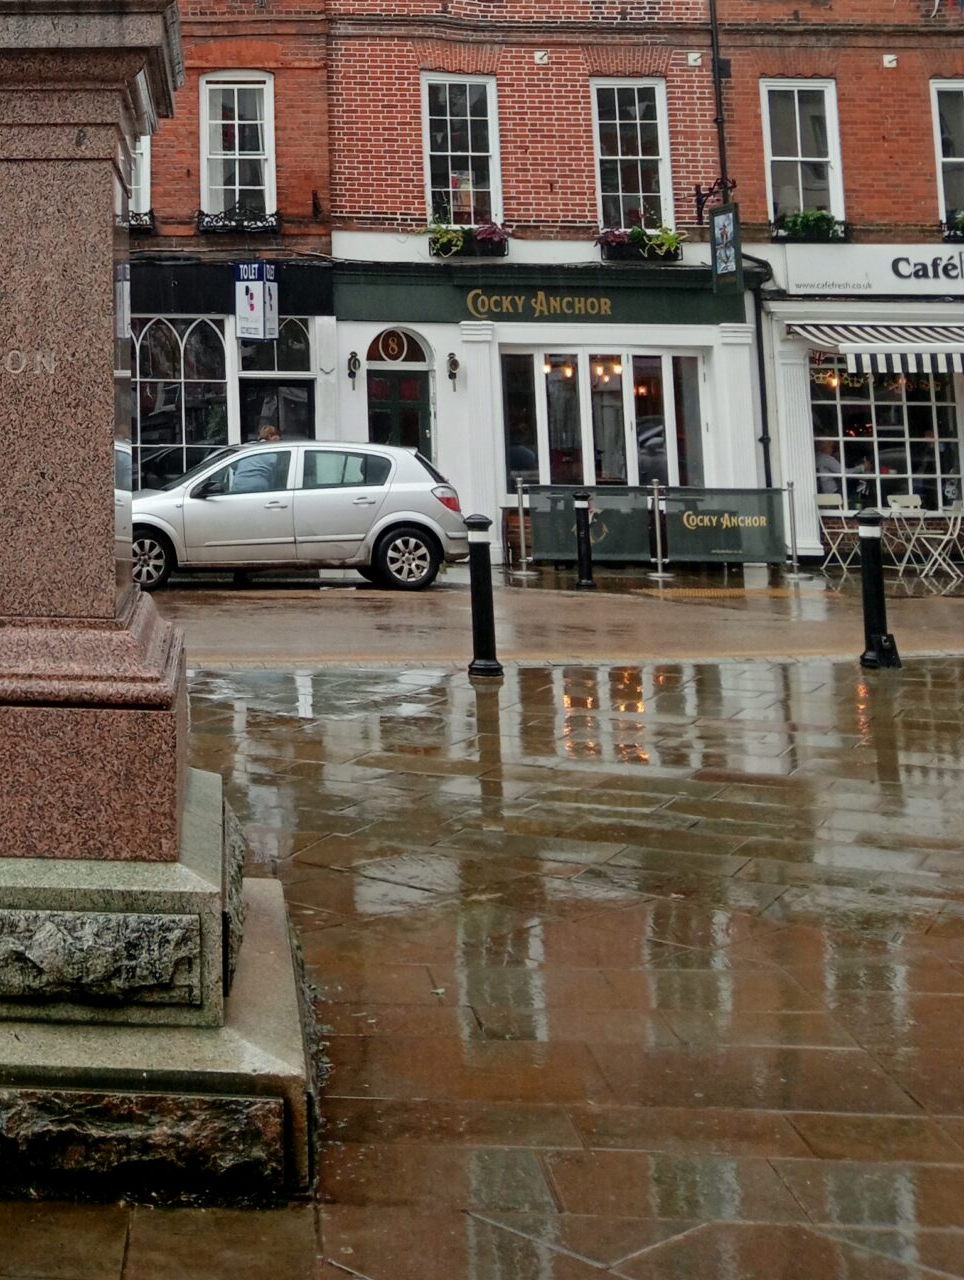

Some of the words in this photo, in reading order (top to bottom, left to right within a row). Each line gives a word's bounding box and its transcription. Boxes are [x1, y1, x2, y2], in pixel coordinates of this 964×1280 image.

[239, 264, 248, 279] TO
[248, 264, 259, 279] LET
[891, 255, 960, 280] Café
[795, 281, 873, 290] www.cafefresh.co.uk
[466, 288, 526, 318] COCKY
[530, 291, 612, 317] ANCHOR
[389, 337, 397, 354] 8
[683, 510, 718, 529] COCKY
[720, 512, 767, 529] ANCHOR
